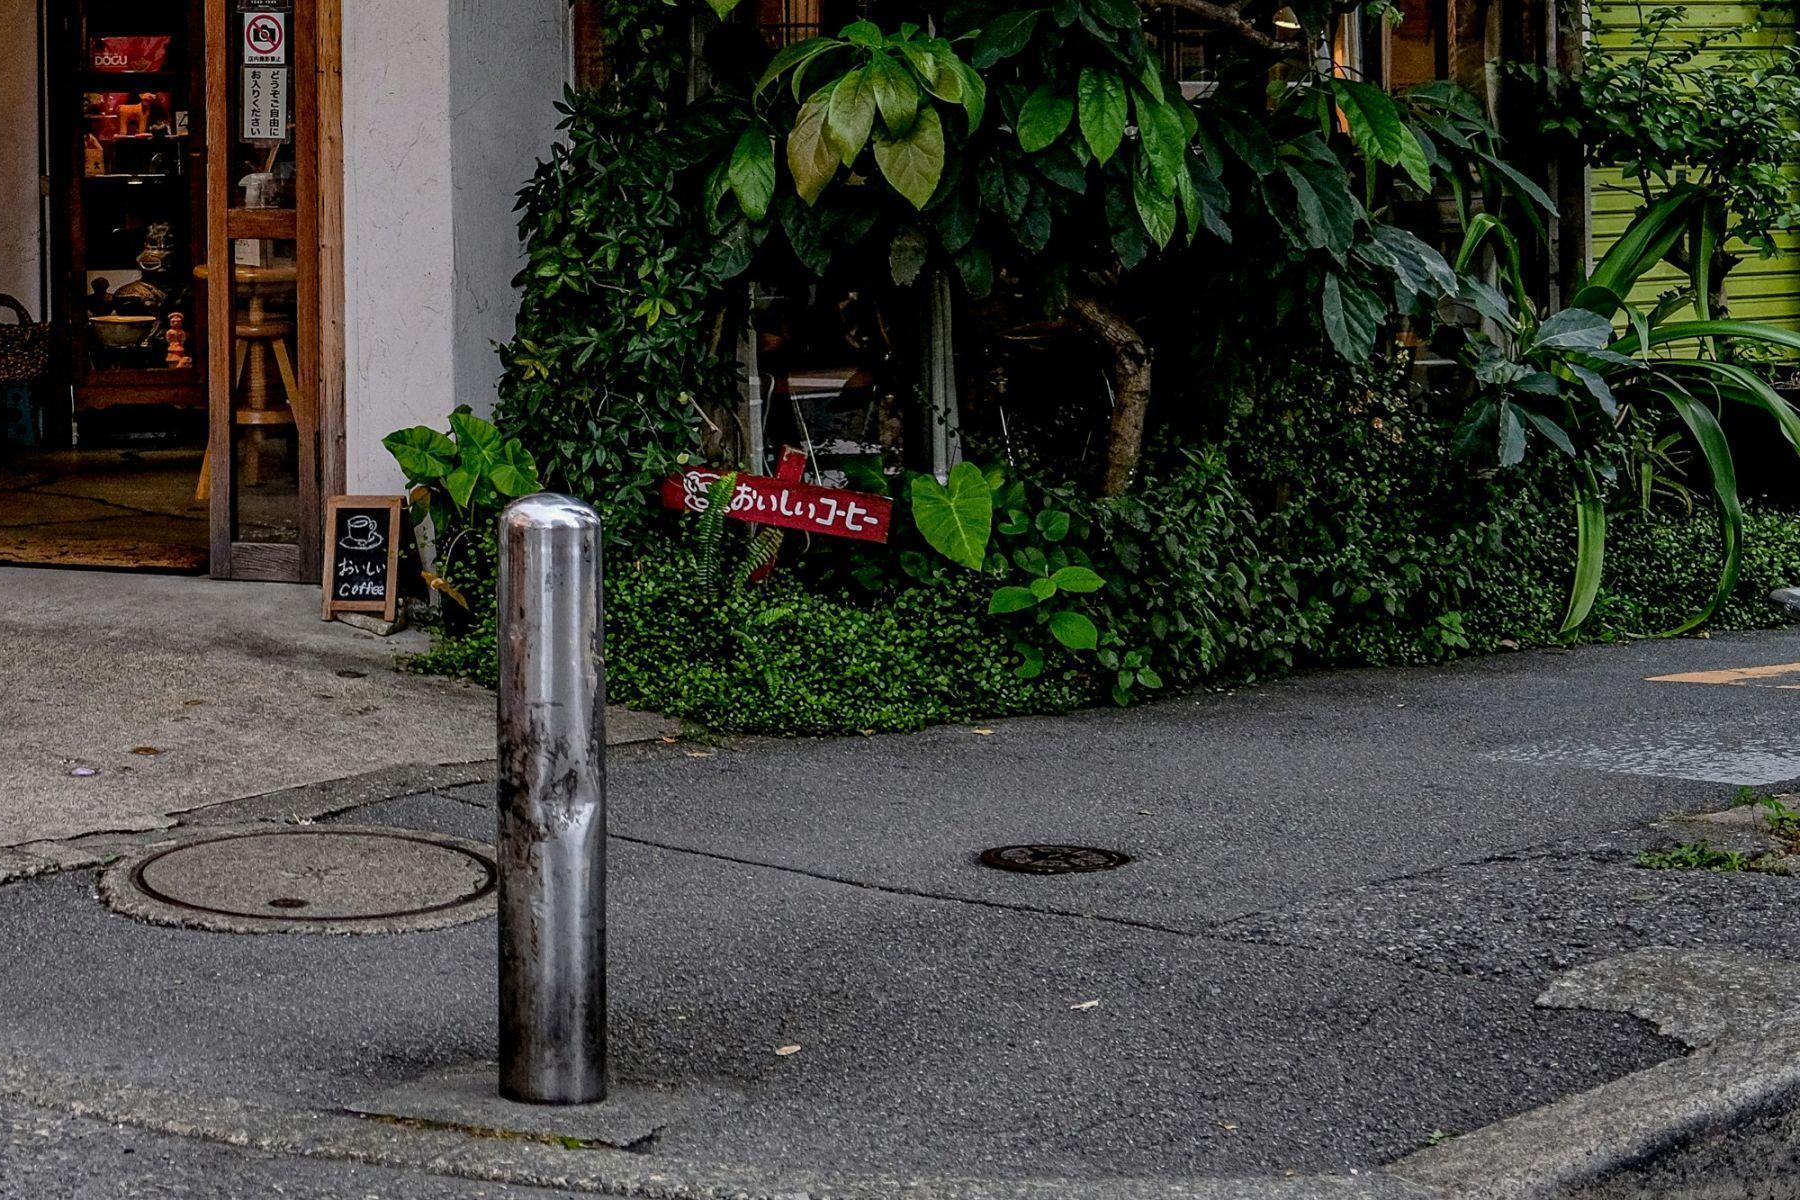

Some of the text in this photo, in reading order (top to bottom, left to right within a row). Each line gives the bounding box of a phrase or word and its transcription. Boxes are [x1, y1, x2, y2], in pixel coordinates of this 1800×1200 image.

[250, 70, 261, 136] お入りください
[269, 70, 280, 137] どうぞご自由に
[731, 483, 879, 532] おいしいコーヒー
[338, 557, 386, 577] おいしい
